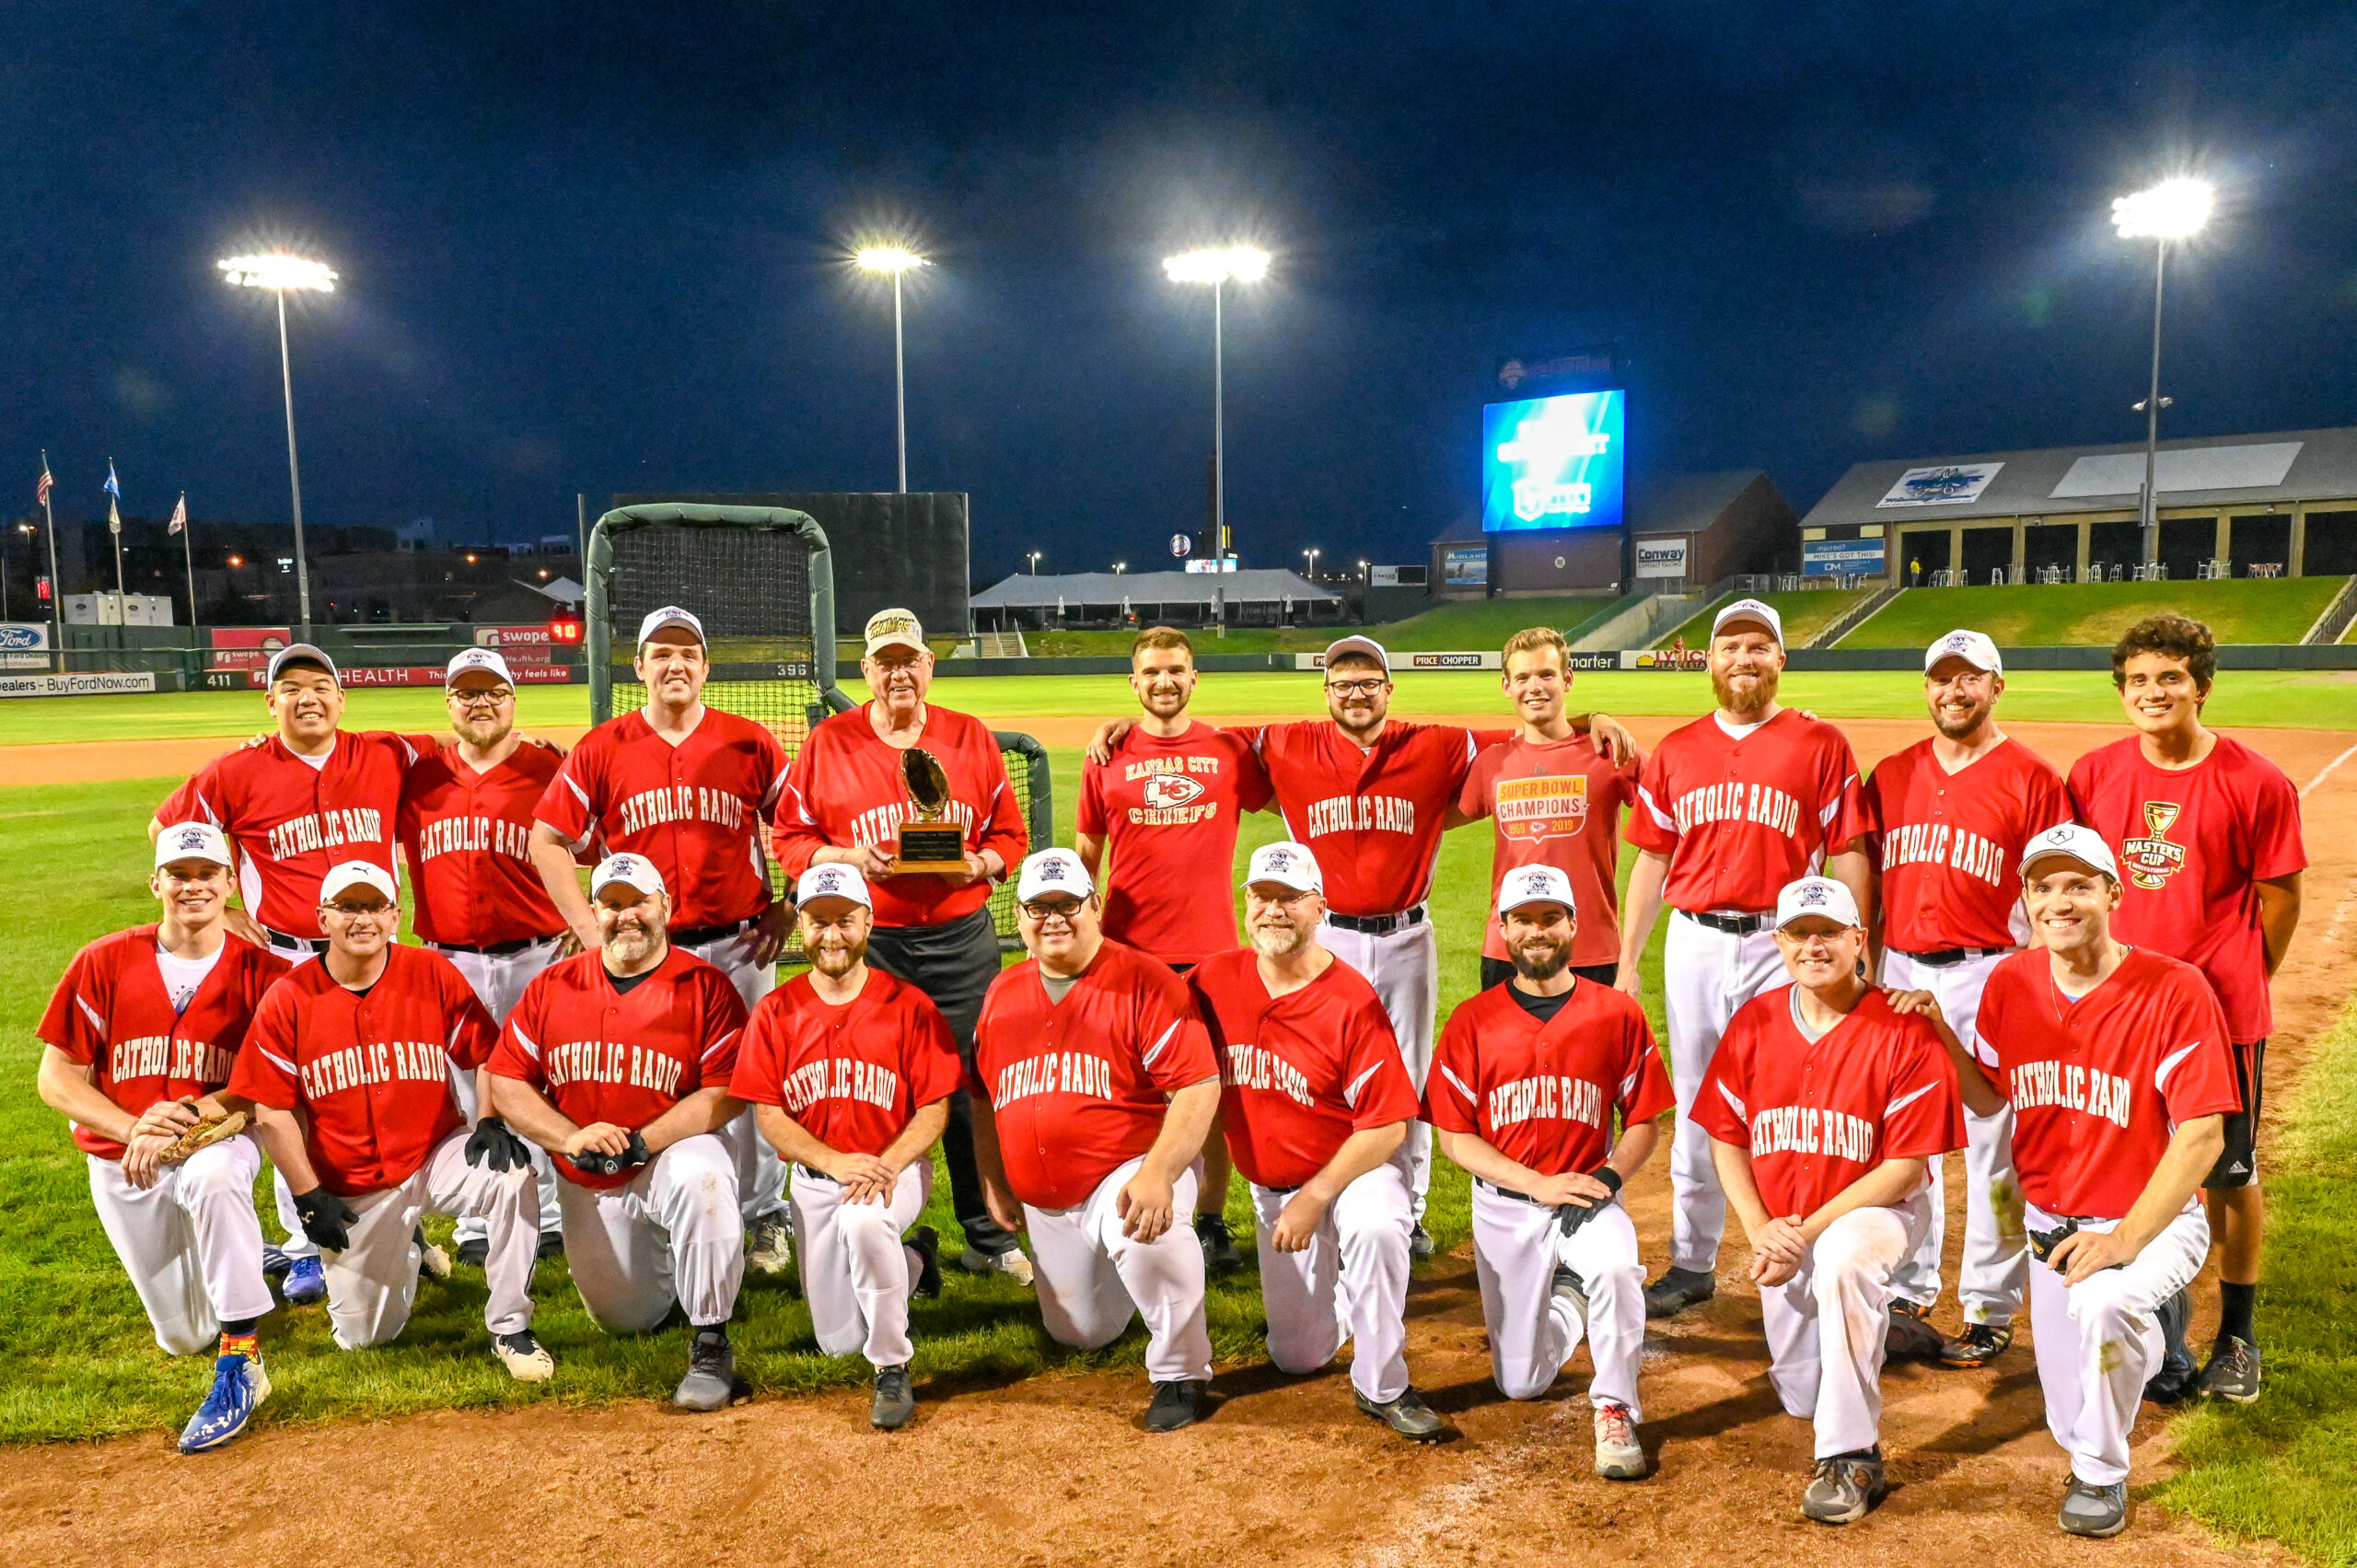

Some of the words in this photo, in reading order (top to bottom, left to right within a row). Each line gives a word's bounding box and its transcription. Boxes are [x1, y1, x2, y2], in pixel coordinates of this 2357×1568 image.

[1638, 549, 1685, 561] Conway
[0, 629, 31, 646] Ford
[503, 632, 550, 643] swope
[870, 619, 911, 640] CHAMPS
[1416, 656, 1438, 665] PRICE
[1442, 656, 1480, 665] CHOPPER
[1568, 655, 1612, 668] marter
[0, 679, 36, 691] ealers
[47, 677, 149, 692] BuyFordNow.com
[207, 674, 231, 687] 411
[338, 668, 408, 682] HEALTH
[525, 669, 548, 678] feels
[550, 668, 567, 677] like
[1125, 756, 1183, 782] KANSAS
[1188, 756, 1219, 773] CITY
[1501, 783, 1538, 799] SUPER
[1541, 780, 1580, 796] BOWL
[620, 786, 693, 837] CATHOLIC
[699, 786, 742, 830] RADIO
[1128, 802, 1217, 825] CHIEFS
[1307, 796, 1372, 839] CATHOLIC
[1375, 796, 1414, 835] RADIO
[1500, 798, 1580, 819] CHAMPIONS
[1672, 782, 1744, 838] CATHOLIC
[1747, 784, 1799, 839] RADIO
[268, 810, 344, 862] CATHOLIC
[343, 807, 382, 843] RADIO
[1551, 819, 1573, 831] 2019
[420, 816, 490, 863] CATHOLIC
[495, 819, 532, 863] RAD
[1950, 828, 2004, 888] RADIO
[2141, 854, 2165, 865] CUP
[112, 1036, 192, 1084] CATHOLIC
[194, 1041, 238, 1083] RADI
[301, 1043, 390, 1100] CATHOLIC
[393, 1041, 446, 1083] RADIO
[548, 1041, 624, 1087] CATHOLIC
[630, 1045, 682, 1096] RADIO
[784, 1058, 852, 1112] CATHOLIC
[853, 1060, 897, 1112] RADIO
[993, 1052, 1058, 1112] CATHOLIC
[1061, 1051, 1112, 1100] RADIO
[2010, 1060, 2085, 1112] CATHOLIC
[1489, 1075, 1557, 1132] CATHOLIC
[1561, 1076, 1602, 1130] RADIO
[1752, 1106, 1818, 1159] CATHOLIC
[1823, 1109, 1874, 1164] RADIO
